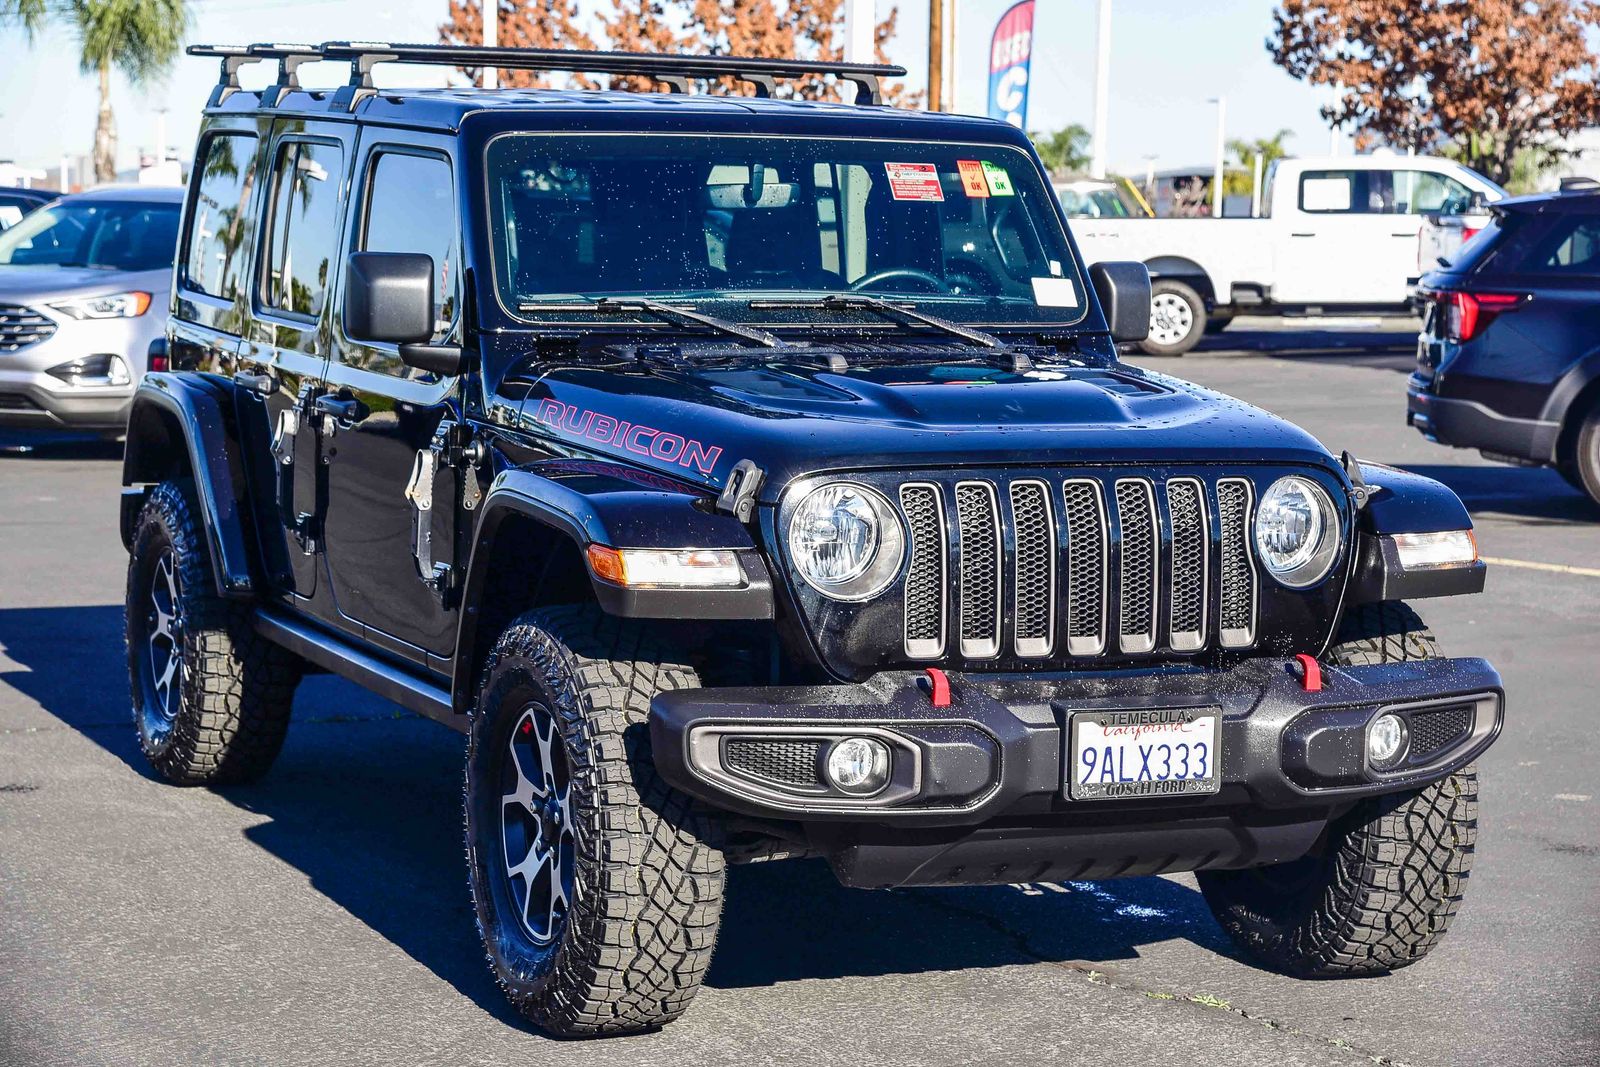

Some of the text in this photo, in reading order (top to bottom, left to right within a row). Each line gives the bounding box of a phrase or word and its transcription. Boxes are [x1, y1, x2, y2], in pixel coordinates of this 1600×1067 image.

[971, 182, 982, 191] OK
[995, 181, 1006, 190] OK
[536, 397, 723, 474] RUBICON
[1110, 710, 1187, 726] TEMECULA
[1081, 742, 1208, 785] 9ALX333
[1154, 780, 1187, 794] FORD
